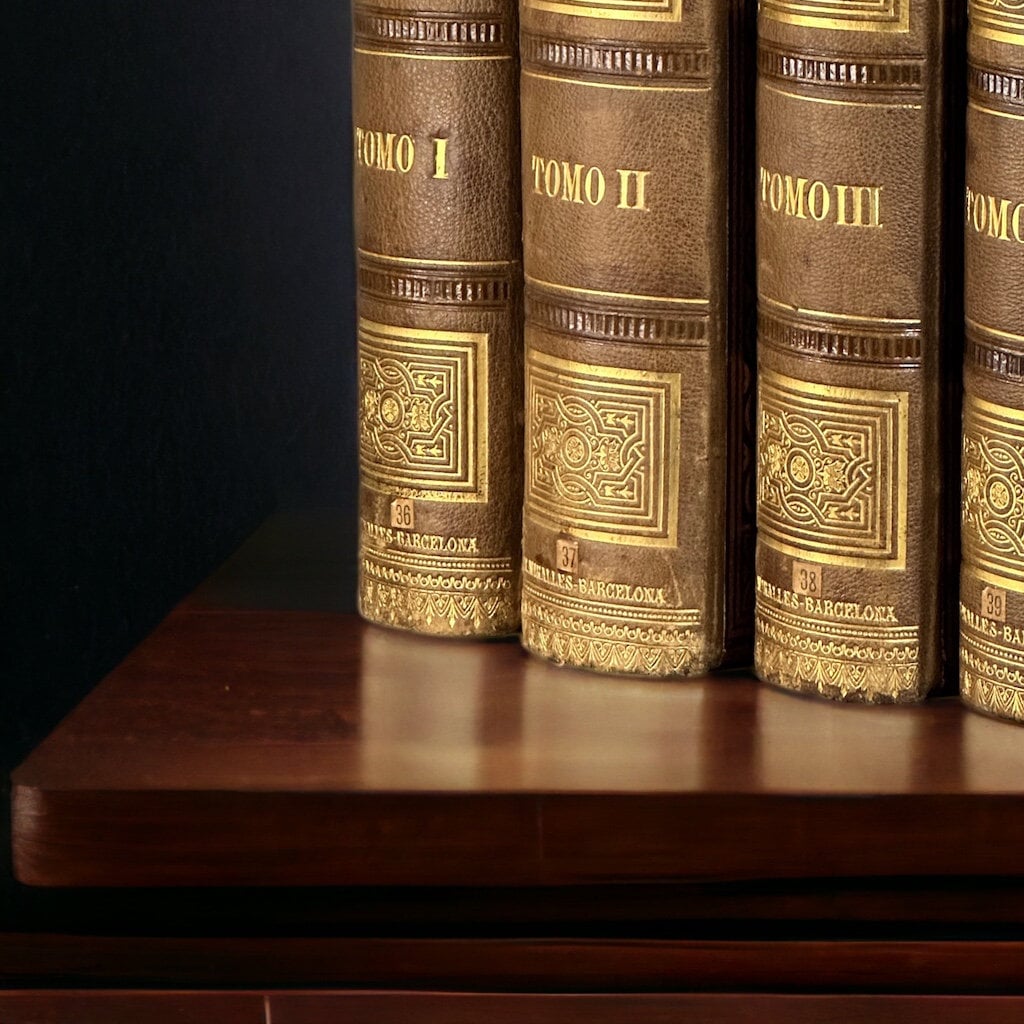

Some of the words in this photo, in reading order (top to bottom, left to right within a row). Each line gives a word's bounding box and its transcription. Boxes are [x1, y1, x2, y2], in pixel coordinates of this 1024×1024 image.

[356, 126, 416, 174] TOMO
[432, 137, 449, 180] I
[531, 154, 606, 207] TOMO
[616, 168, 651, 212] II
[760, 166, 831, 222] TOMO
[833, 183, 884, 229] III
[395, 504, 412, 526] 36
[561, 545, 577, 569] 37
[799, 568, 818, 593] 38
[986, 592, 1003, 617] 39
